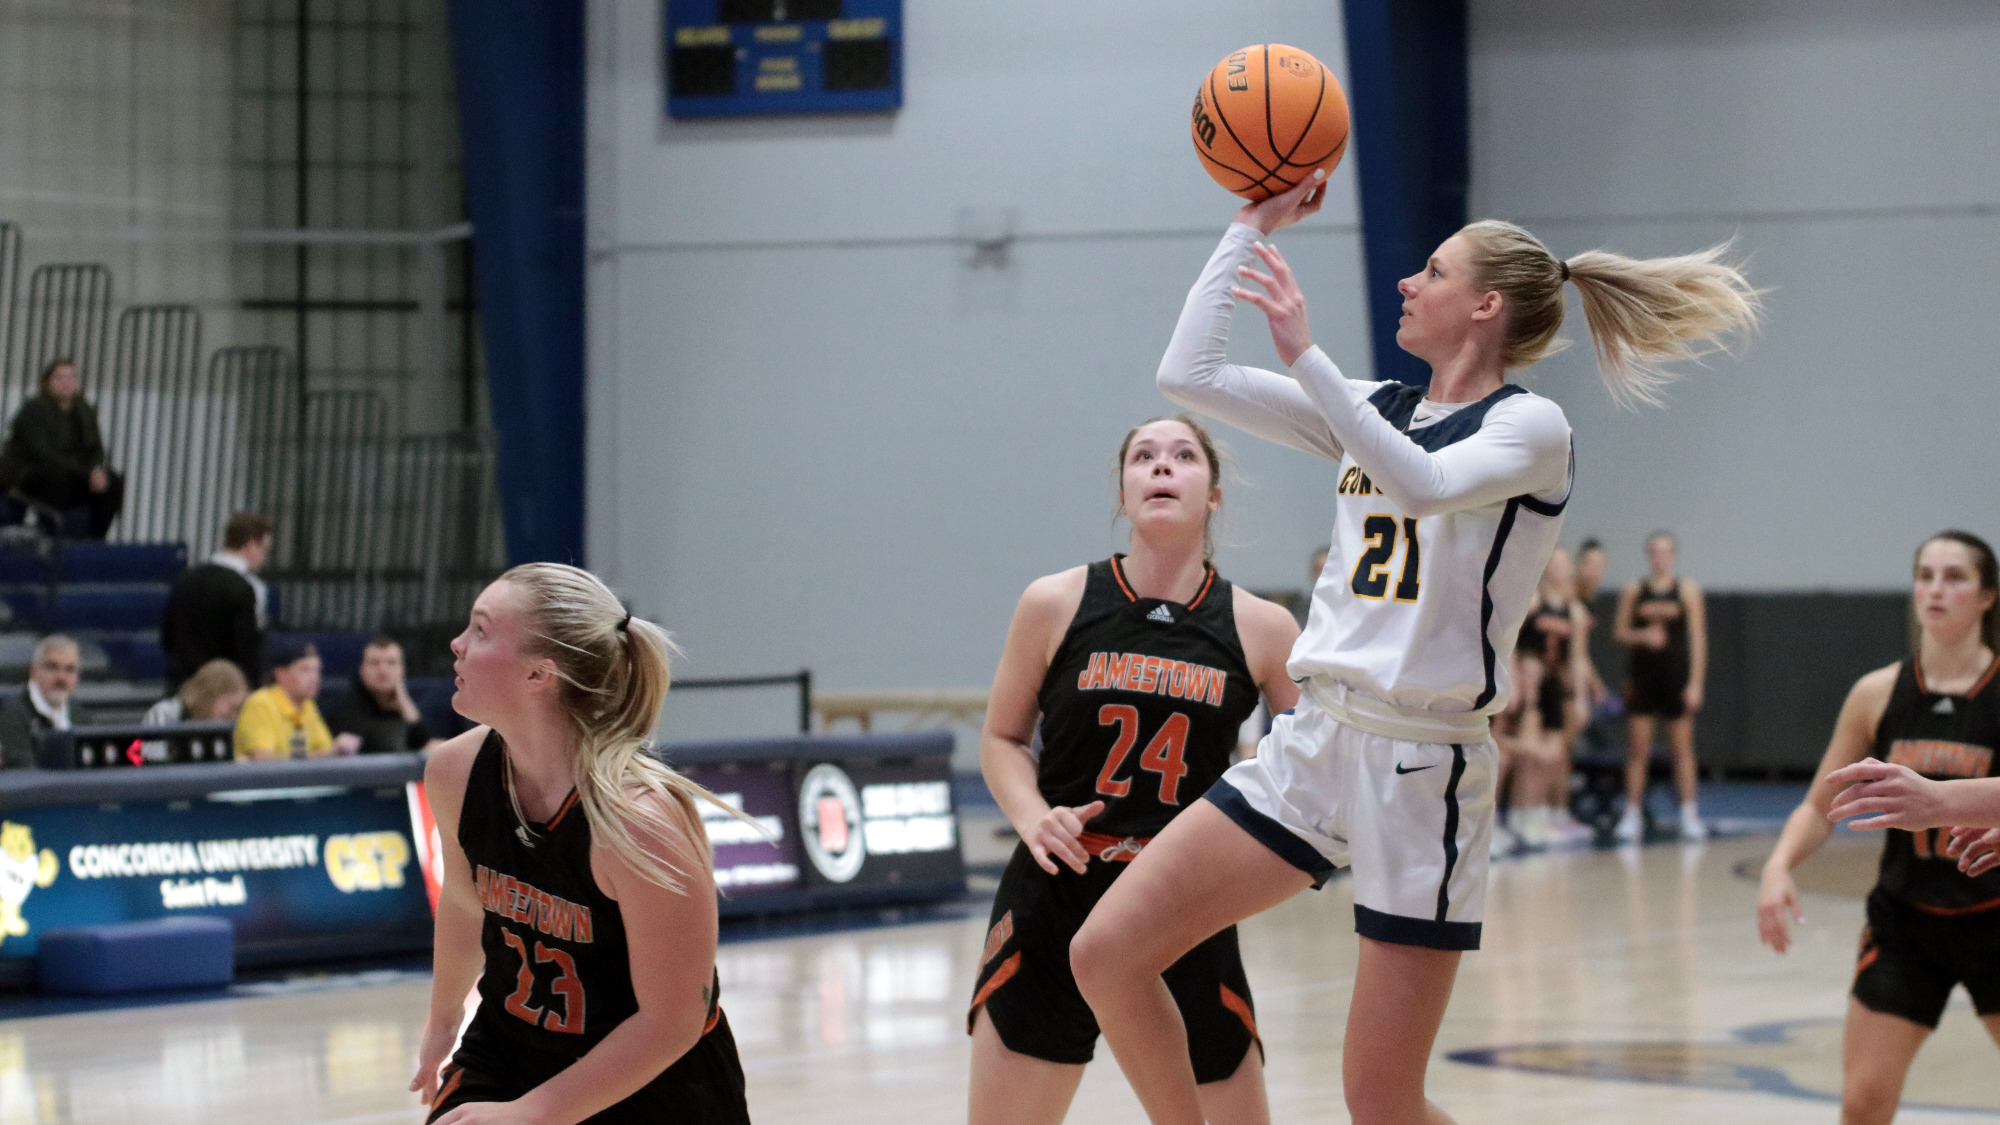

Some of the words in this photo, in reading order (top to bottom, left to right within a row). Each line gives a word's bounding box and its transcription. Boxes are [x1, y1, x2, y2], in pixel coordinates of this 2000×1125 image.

[1351, 513, 1421, 604] 21
[1147, 613, 1175, 624] adidas
[1078, 652, 1227, 707] JAMESTOWN
[1096, 703, 1190, 806] 24
[69, 842, 197, 879] CONCORDIA
[198, 834, 319, 872] UNIVERSITY
[324, 830, 411, 894] CSP
[160, 878, 204, 909] Saint
[204, 875, 248, 906] Paul
[501, 926, 586, 1034] 23
